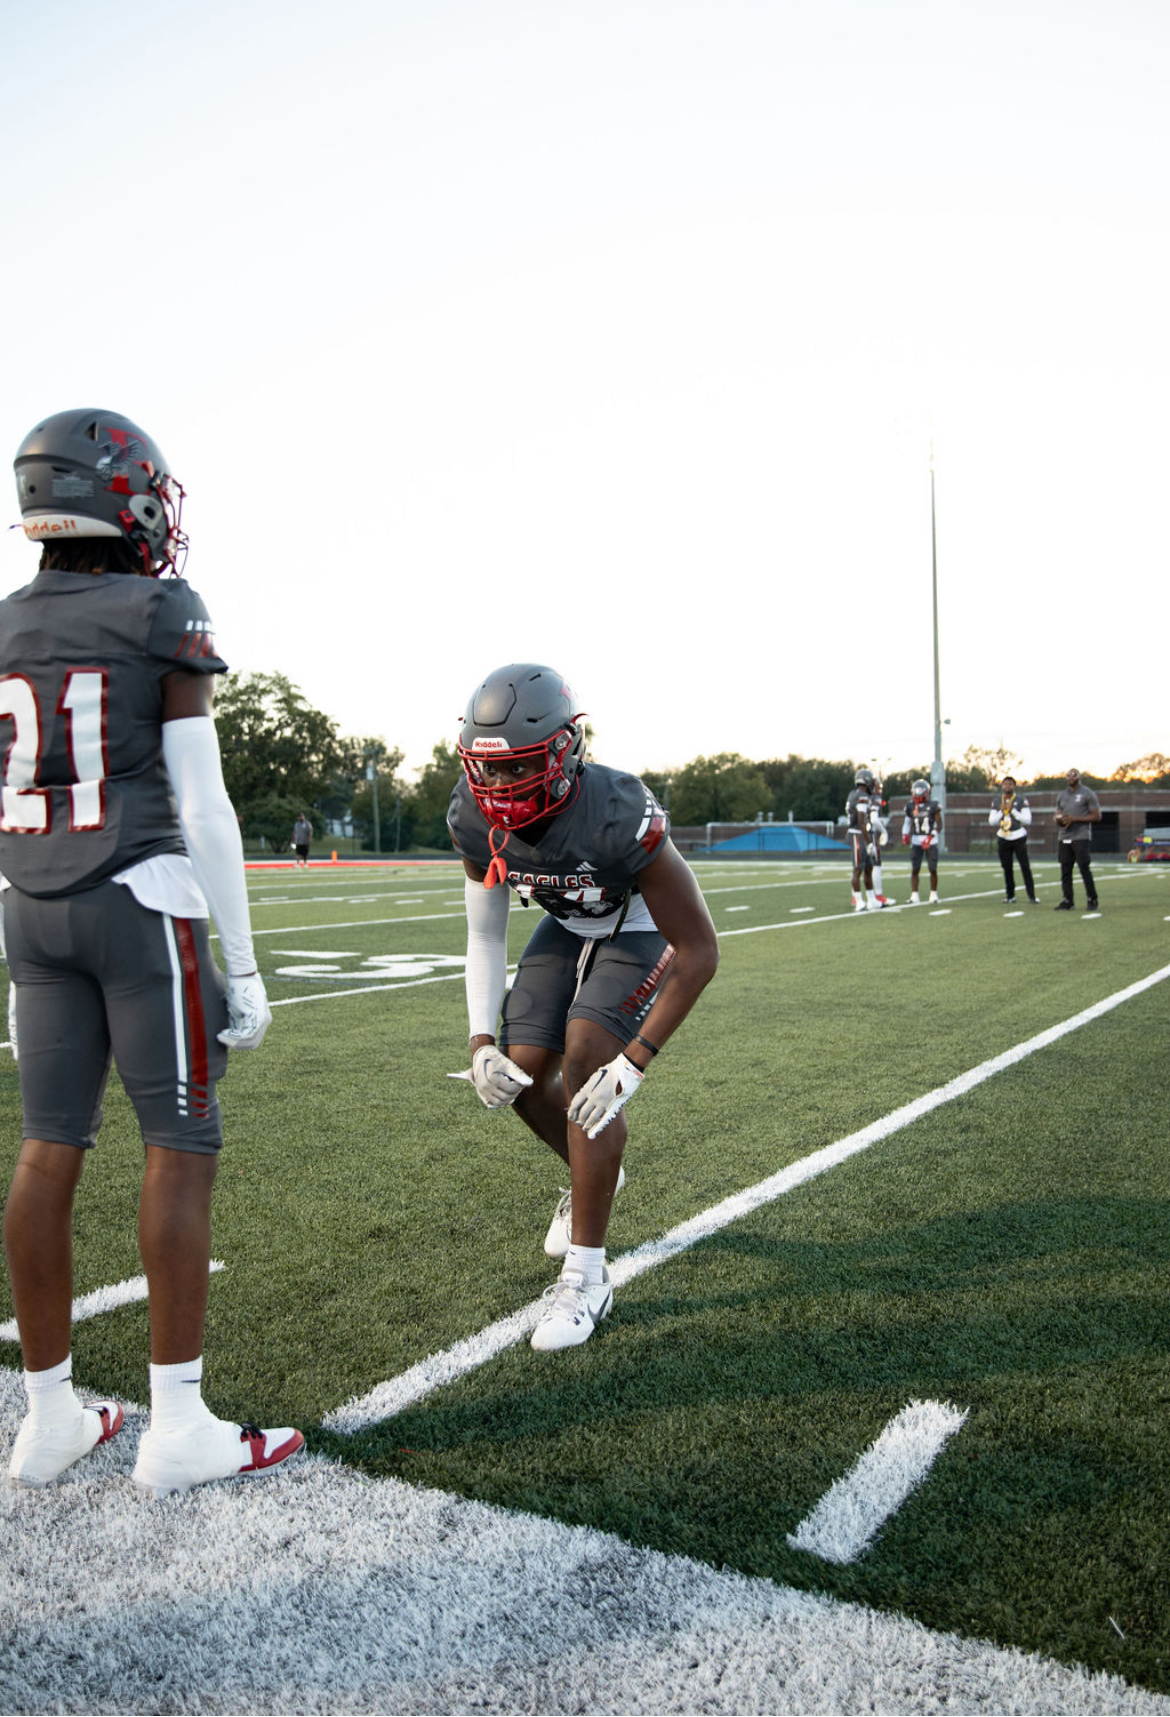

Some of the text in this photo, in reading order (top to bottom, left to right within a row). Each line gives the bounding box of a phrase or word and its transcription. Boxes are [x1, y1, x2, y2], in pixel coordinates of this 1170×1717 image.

[23, 519, 77, 535] iddell
[0, 666, 110, 834] 21
[914, 817, 931, 834] 14
